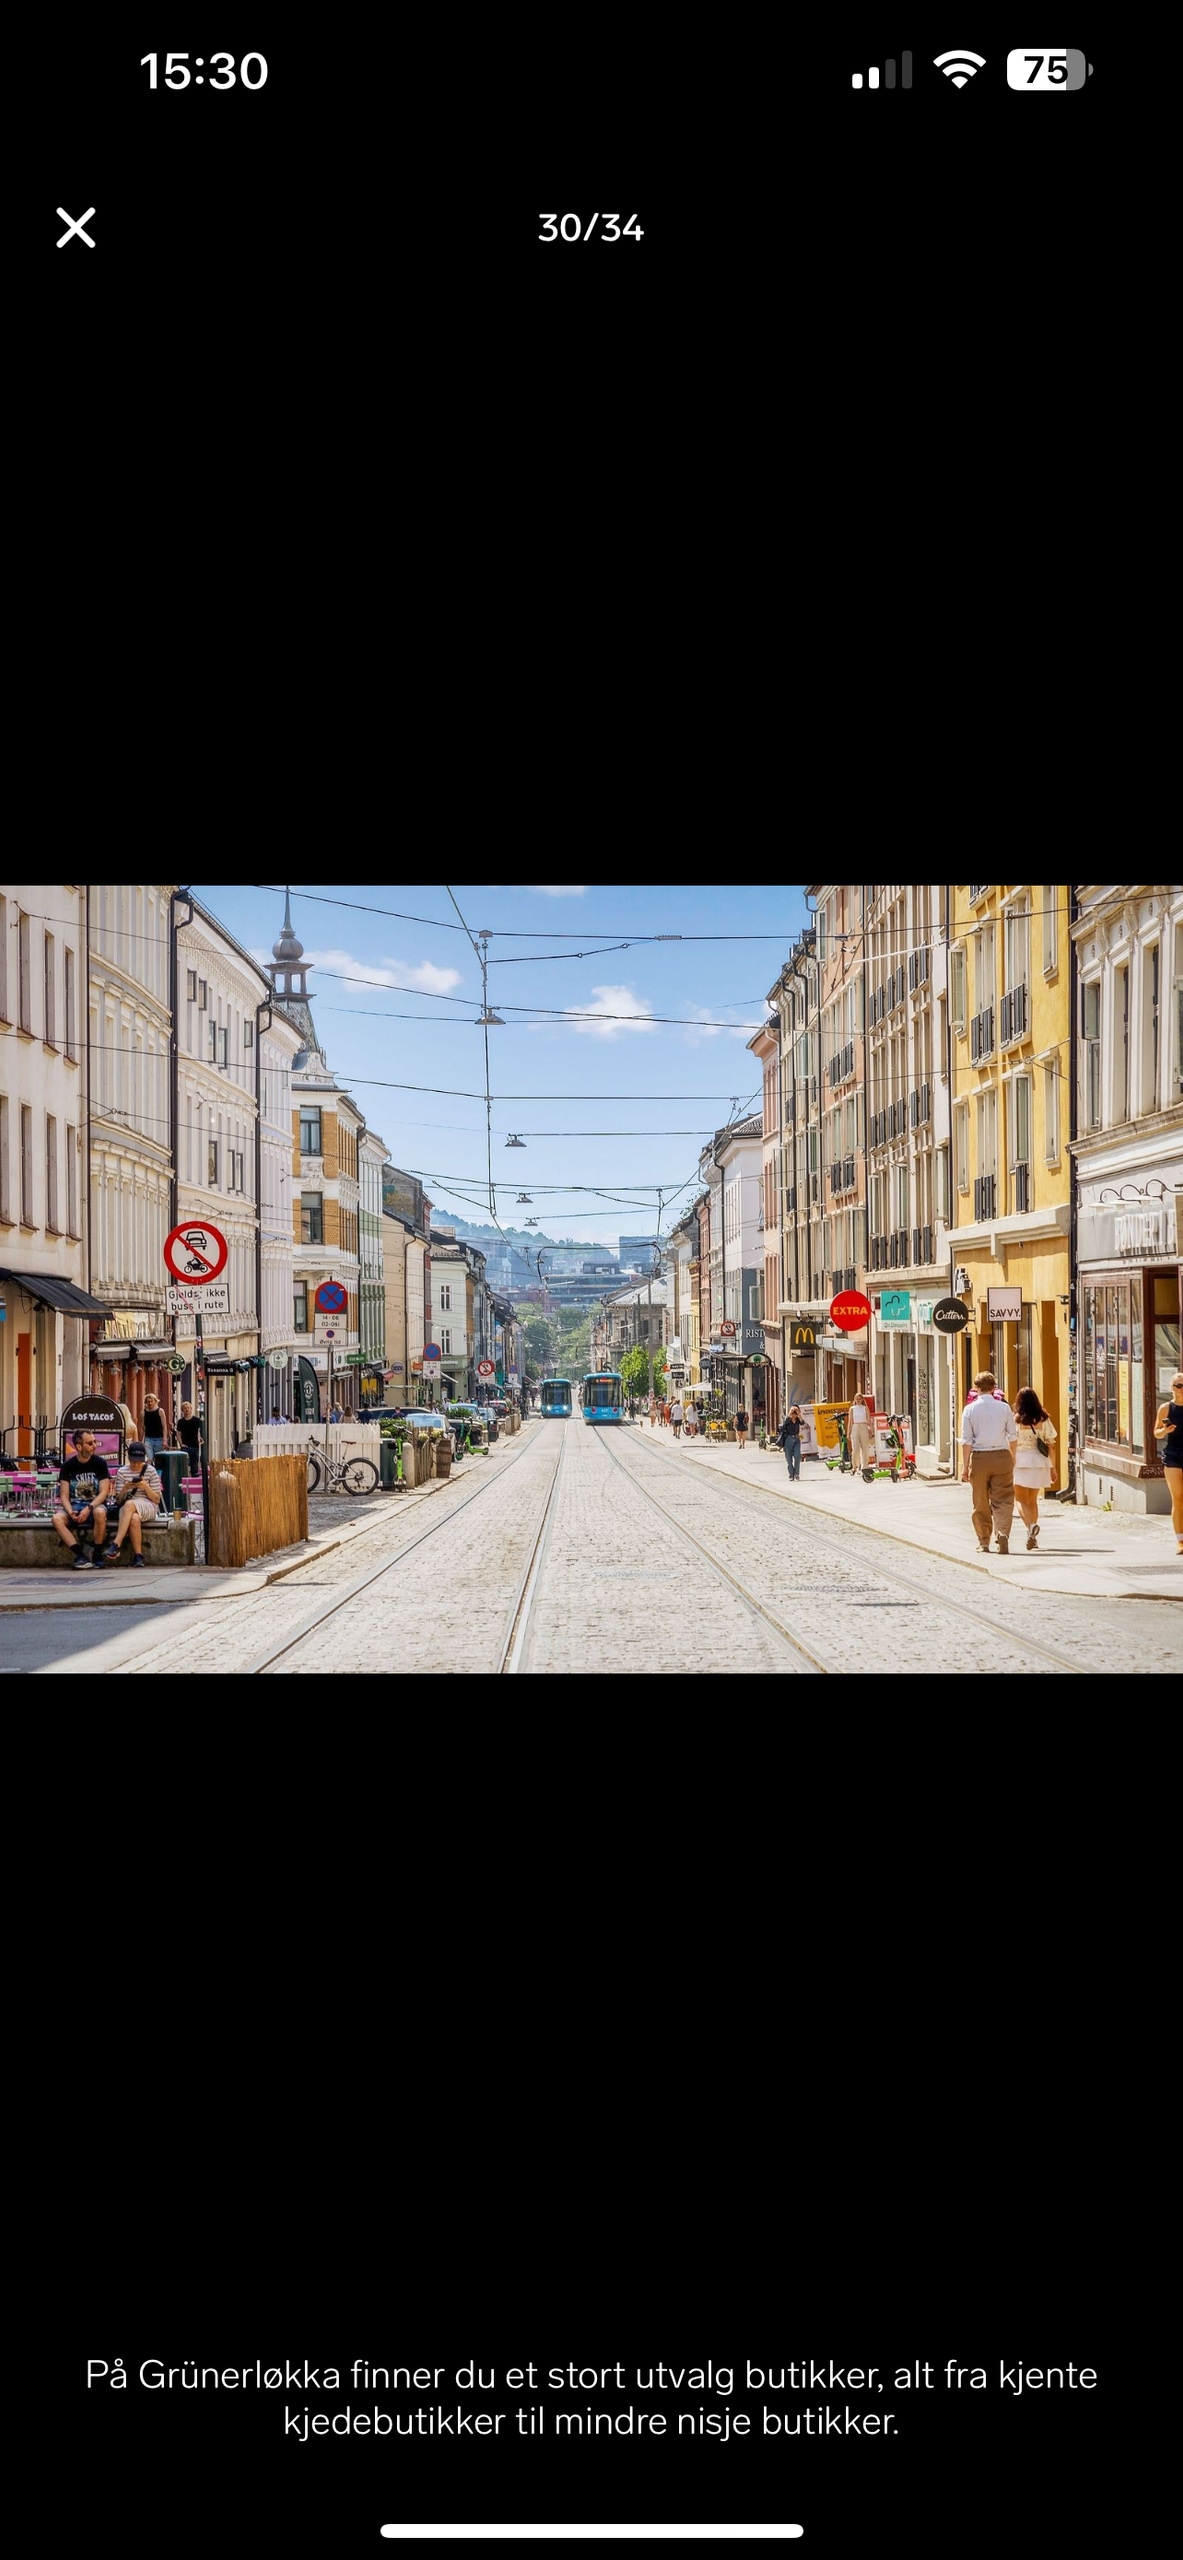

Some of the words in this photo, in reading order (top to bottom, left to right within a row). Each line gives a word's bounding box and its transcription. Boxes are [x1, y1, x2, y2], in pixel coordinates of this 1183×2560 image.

[206, 1288, 226, 1297] ikke
[171, 1302, 194, 1310] buss
[197, 1301, 201, 1309] i
[204, 1301, 224, 1309] rute
[832, 1307, 868, 1316] EXTRA
[72, 1413, 88, 1421] LOS
[88, 1413, 115, 1421] TACOS
